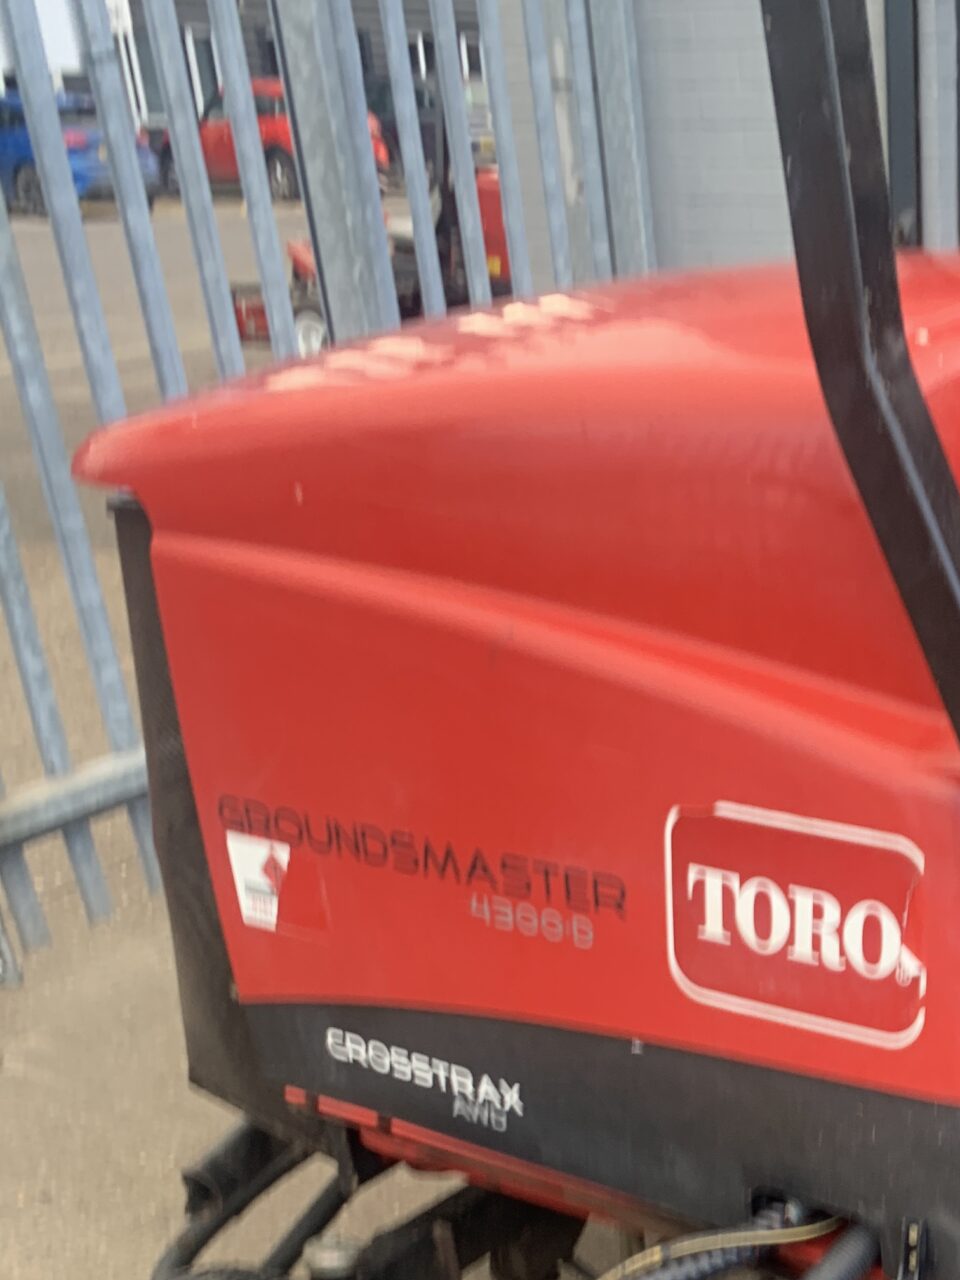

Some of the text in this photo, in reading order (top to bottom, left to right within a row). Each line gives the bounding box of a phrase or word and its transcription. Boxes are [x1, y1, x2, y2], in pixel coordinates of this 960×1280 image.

[218, 794, 627, 920] GROUNDSMASTER
[687, 862, 901, 980] TORO
[326, 1027, 524, 1116] CROSSTRAX
